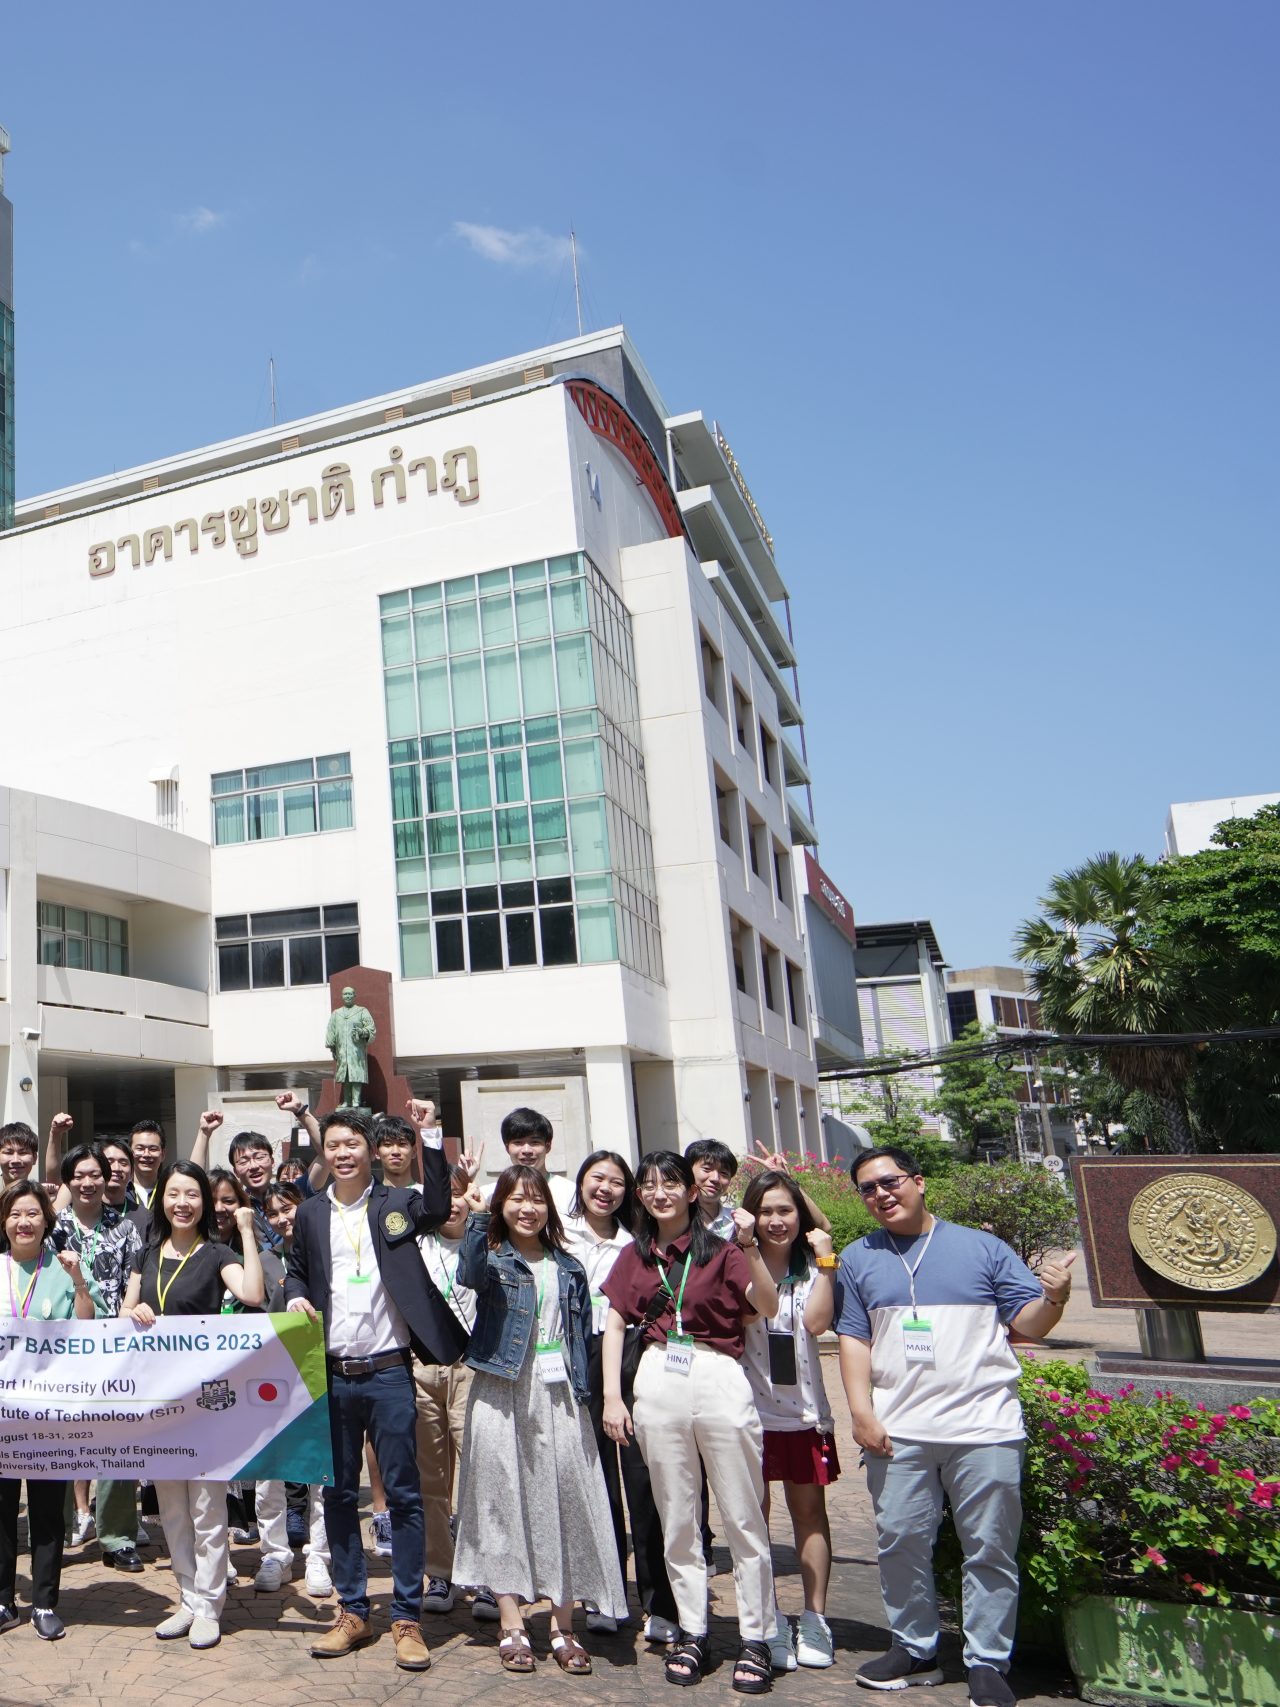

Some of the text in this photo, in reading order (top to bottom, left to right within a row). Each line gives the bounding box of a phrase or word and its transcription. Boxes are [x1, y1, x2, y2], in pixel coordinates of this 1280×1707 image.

[88, 445, 481, 577] อาคารชูชาติ กำภู
[25, 1336, 95, 1355] BASED
[102, 1334, 210, 1354] LEARNING
[216, 1333, 263, 1351] 2023
[906, 1344, 932, 1352] MARK
[666, 1353, 689, 1366] HINA
[22, 1378, 97, 1396] University
[101, 1378, 136, 1397] (KU)
[34, 1408, 50, 1422] of
[54, 1408, 145, 1423] Technology
[149, 1404, 185, 1420] (SIT)
[31, 1431, 65, 1441] 18-31,
[68, 1431, 94, 1439] 2023
[12, 1447, 77, 1461] Engineering,
[79, 1445, 117, 1457] Faculty
[120, 1445, 131, 1455] of
[133, 1445, 198, 1457] Engineering,
[50, 1459, 99, 1470] Bangkok,
[101, 1459, 146, 1469] Thailand
